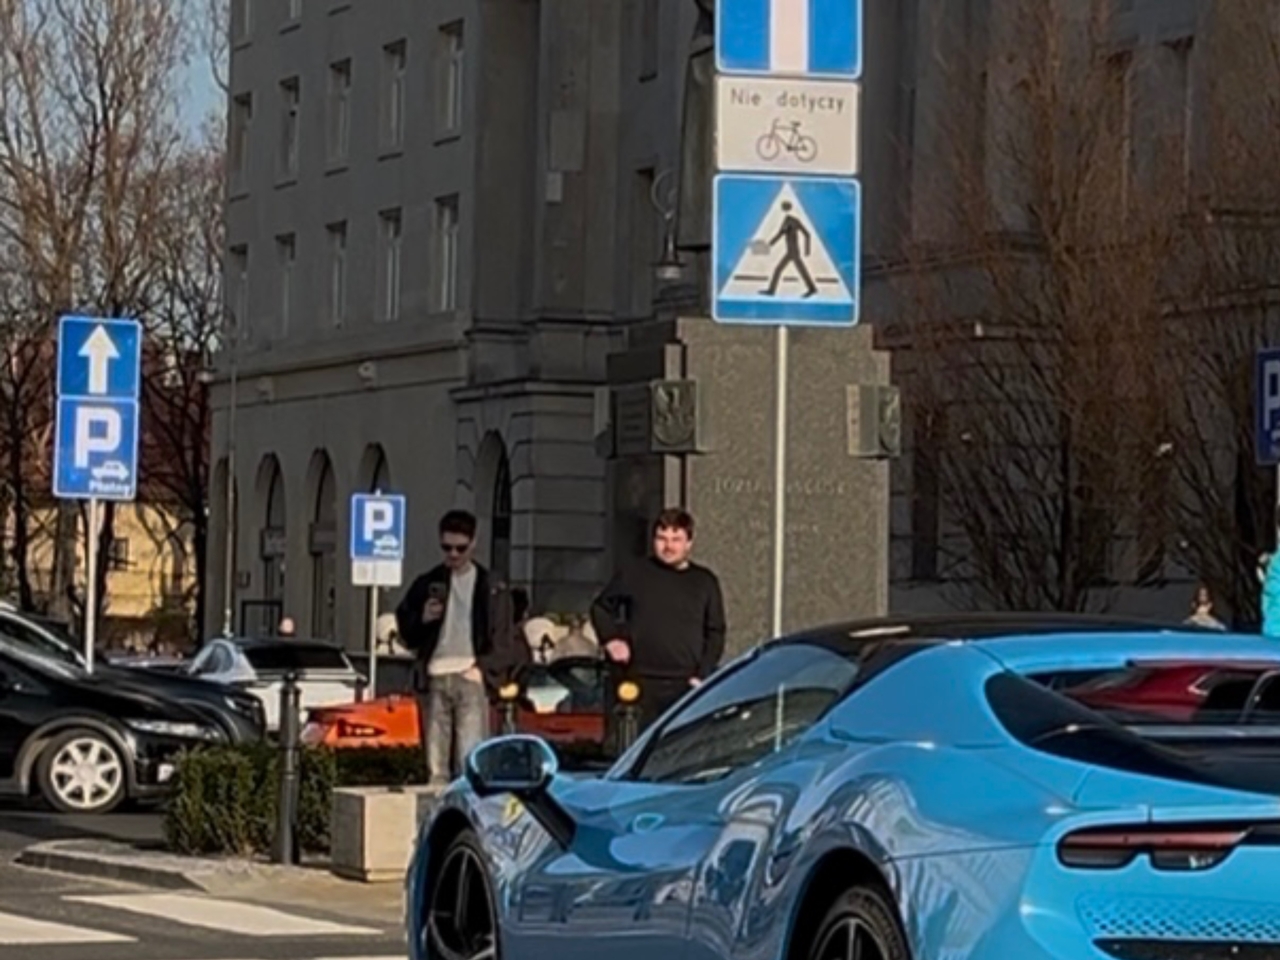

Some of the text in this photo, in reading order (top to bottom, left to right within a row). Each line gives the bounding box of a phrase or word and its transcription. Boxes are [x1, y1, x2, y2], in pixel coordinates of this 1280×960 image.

[730, 88, 845, 113] Nie dotyczy
[74, 406, 121, 468] P
[364, 502, 393, 541] P
